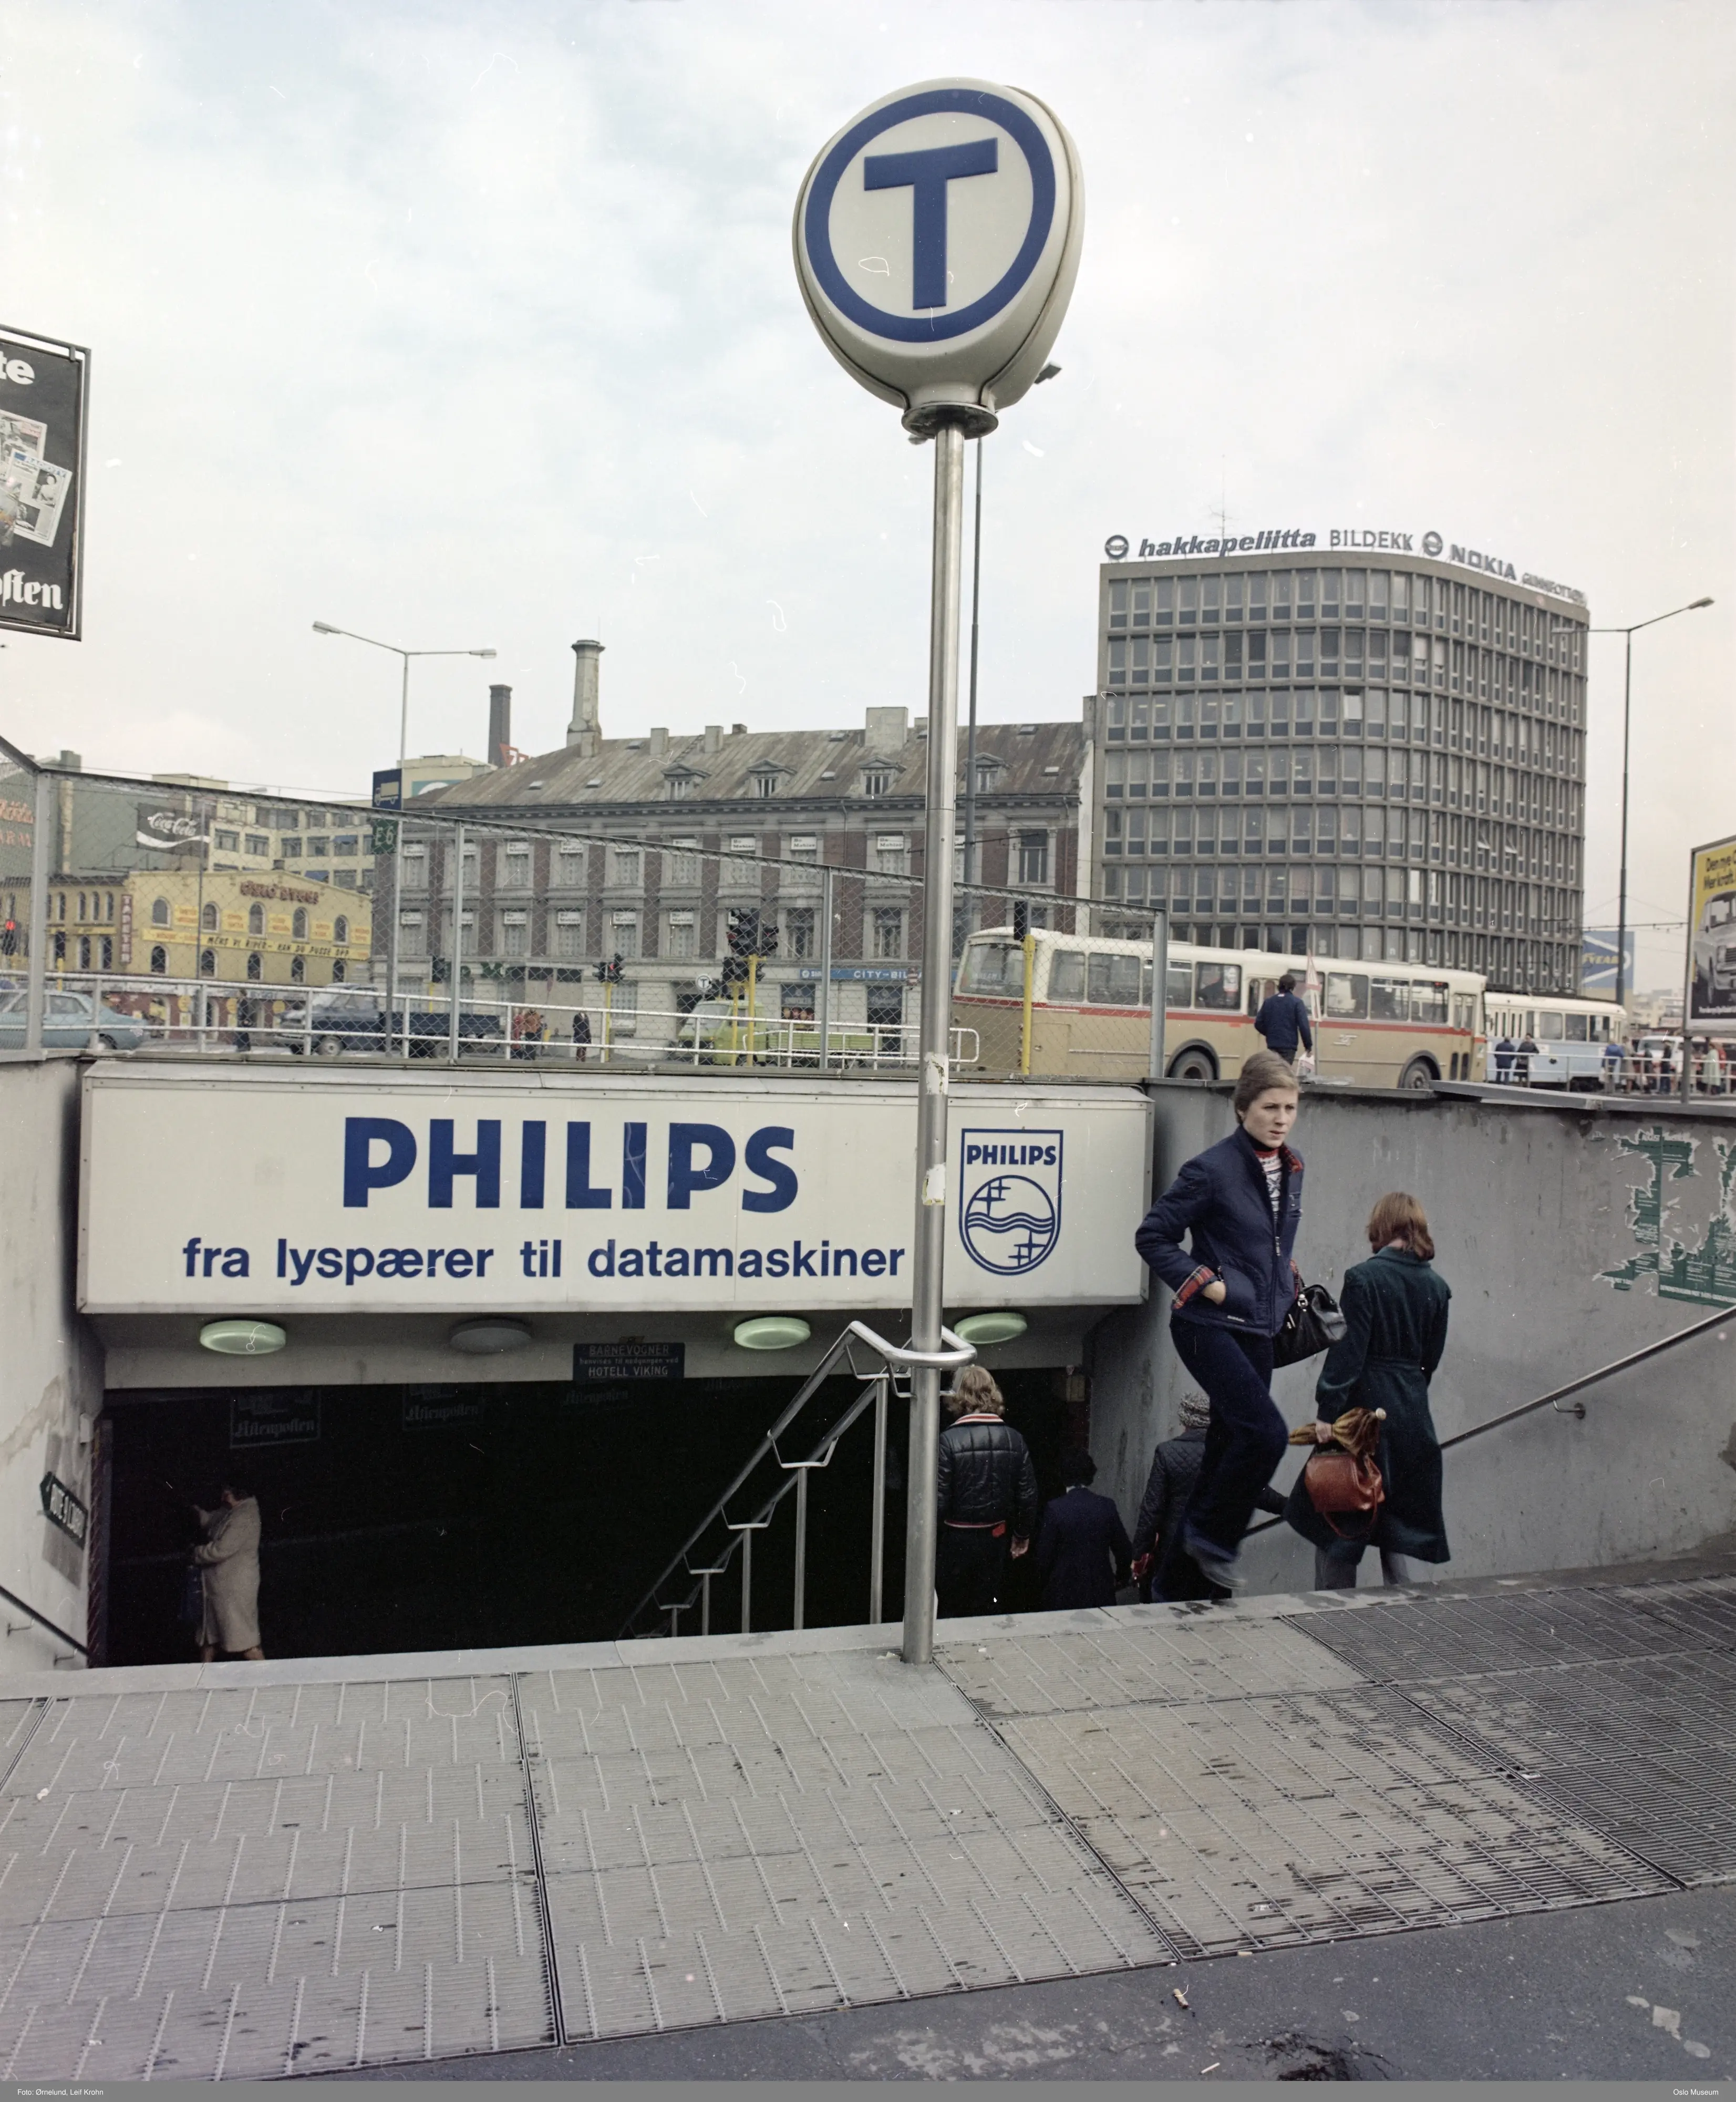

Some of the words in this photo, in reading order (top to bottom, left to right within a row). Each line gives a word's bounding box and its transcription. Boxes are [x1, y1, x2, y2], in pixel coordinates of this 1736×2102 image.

[864, 137, 998, 310] T
[1139, 530, 1316, 557] hakkapeliitta
[1330, 530, 1413, 551] BILDEKK
[1451, 544, 1517, 580] NOKIA
[344, 1117, 798, 1213] PHILIPS
[967, 1145, 1057, 1166] PHILIPS
[183, 1238, 250, 1277] fra
[277, 1239, 493, 1286] lyspærer
[520, 1239, 561, 1277] til
[588, 1239, 905, 1278] datamaskiner
[589, 1345, 669, 1355] BARNEVOGNER
[588, 1367, 629, 1377] HOTELL
[633, 1366, 668, 1376] VIKING
